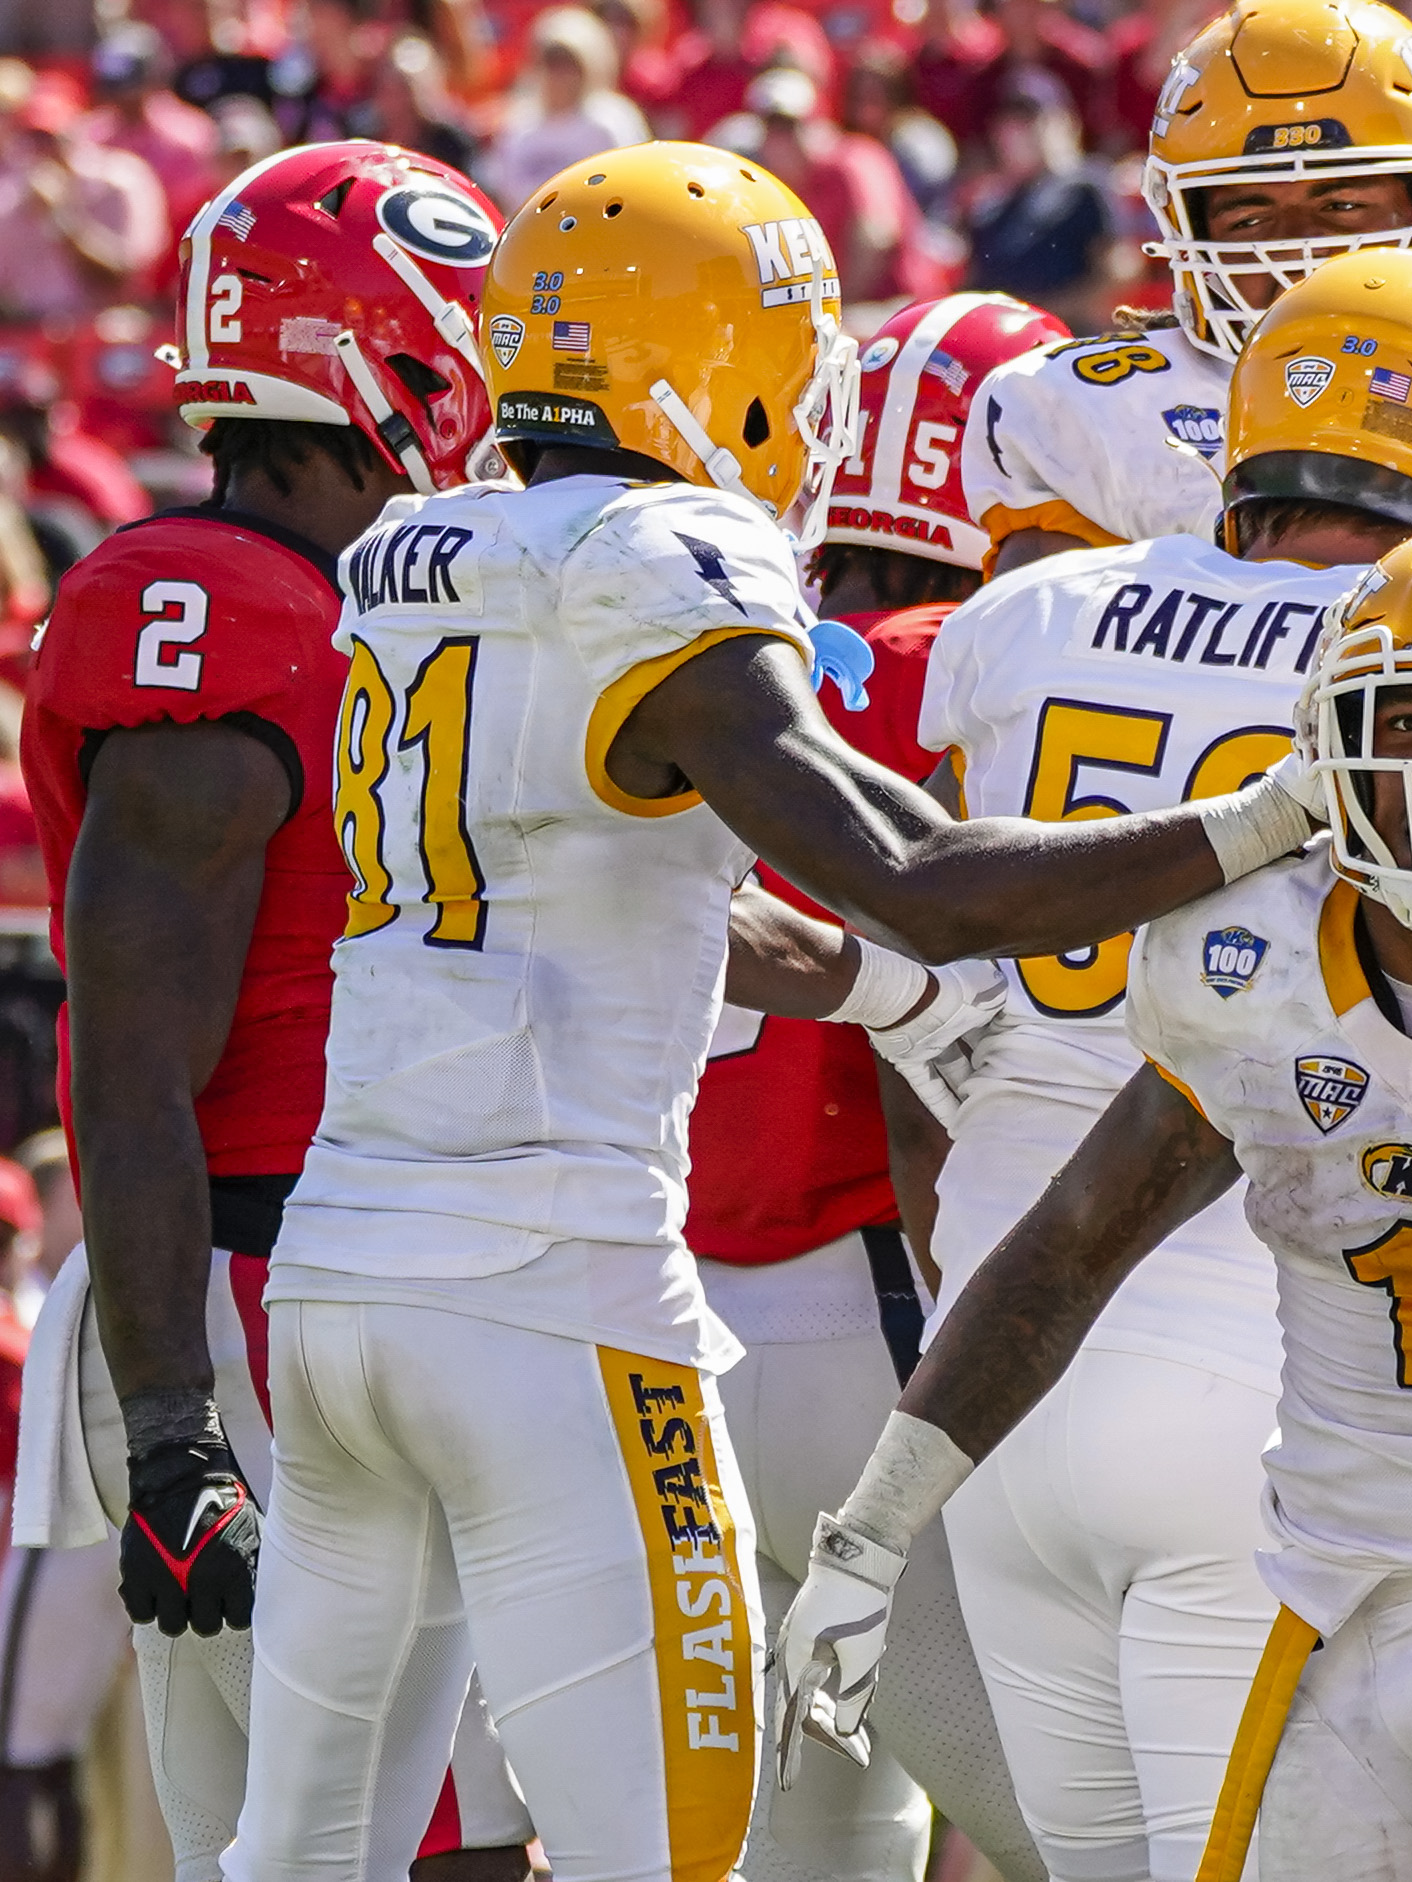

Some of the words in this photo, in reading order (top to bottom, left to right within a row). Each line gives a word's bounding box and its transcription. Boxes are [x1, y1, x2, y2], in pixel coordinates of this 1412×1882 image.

[1273, 124, 1322, 147] 330
[381, 188, 493, 262] G
[533, 272, 564, 291] 3.0
[210, 275, 242, 342] 2
[530, 296, 561, 315] 3.0
[492, 333, 520, 347] MAC
[1340, 333, 1378, 357] 3.0
[1288, 373, 1329, 388] MAC
[501, 402, 515, 419] Be
[515, 403, 538, 421] The
[1172, 419, 1219, 442] 100
[134, 578, 209, 693] 2
[332, 632, 490, 953] 81
[1208, 943, 1257, 976] 100
[1300, 1076, 1362, 1106] MAC
